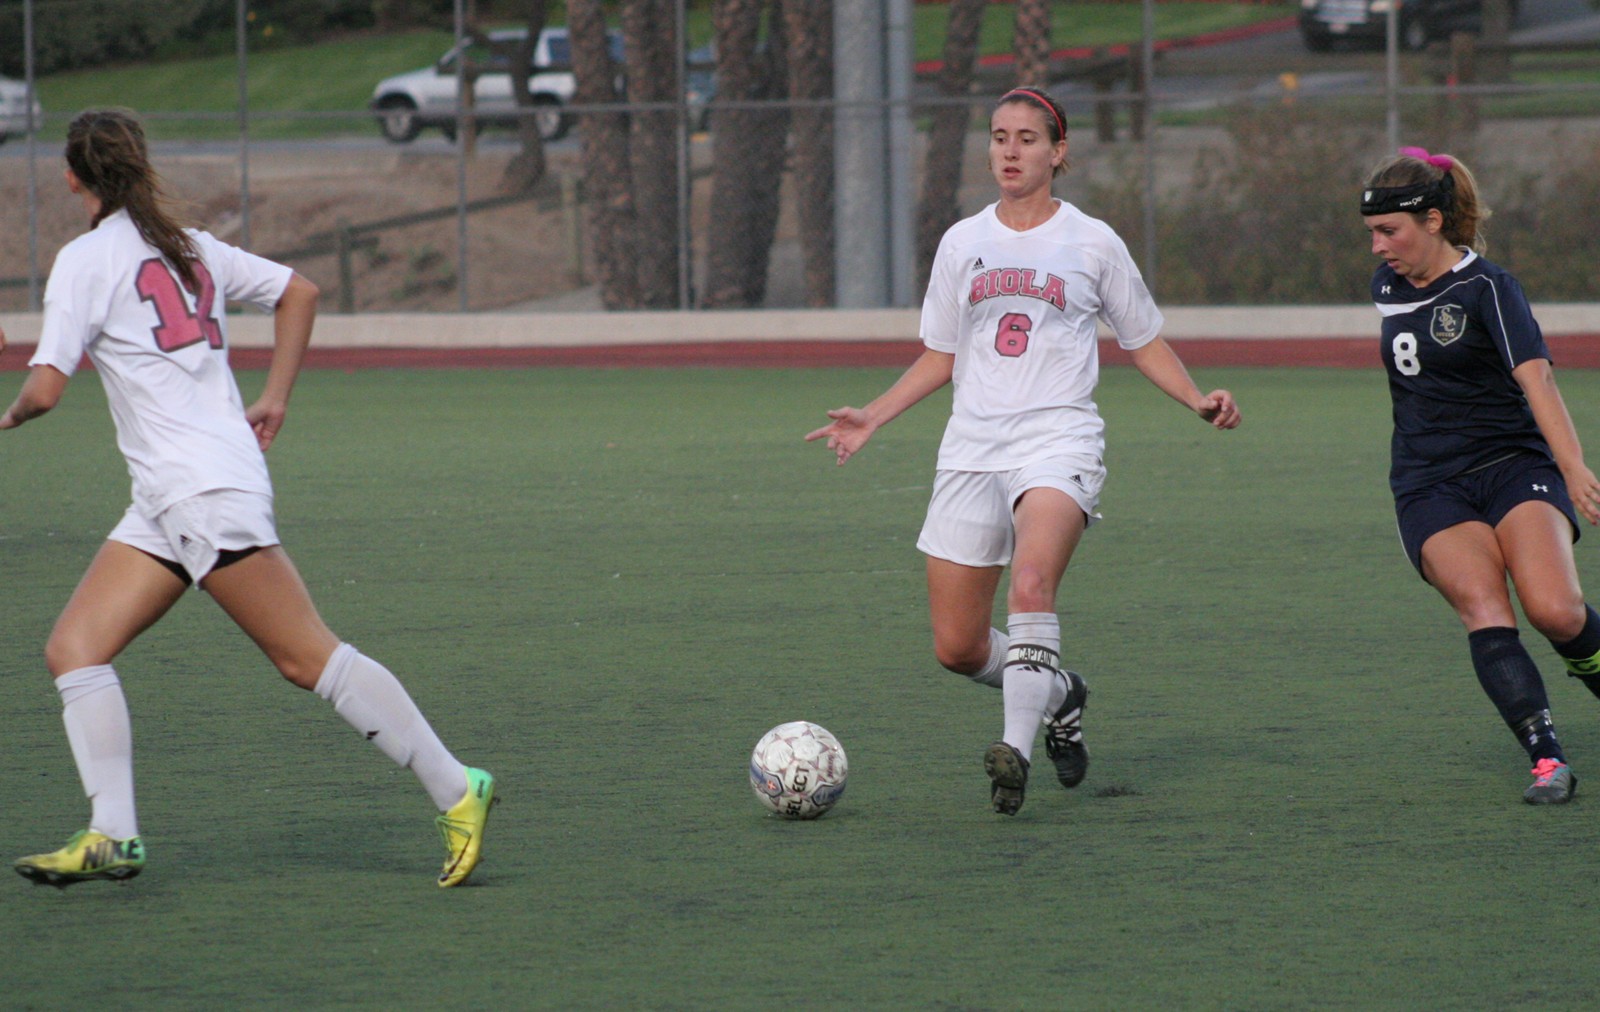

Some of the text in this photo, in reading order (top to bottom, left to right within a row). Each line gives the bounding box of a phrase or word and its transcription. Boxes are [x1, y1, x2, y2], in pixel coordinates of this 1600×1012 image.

[969, 268, 1066, 311] BIOLA
[994, 312, 1032, 357] 6
[1392, 332, 1421, 376] 8
[1018, 648, 1052, 665] CAPTAIN
[786, 766, 809, 815] SELECT
